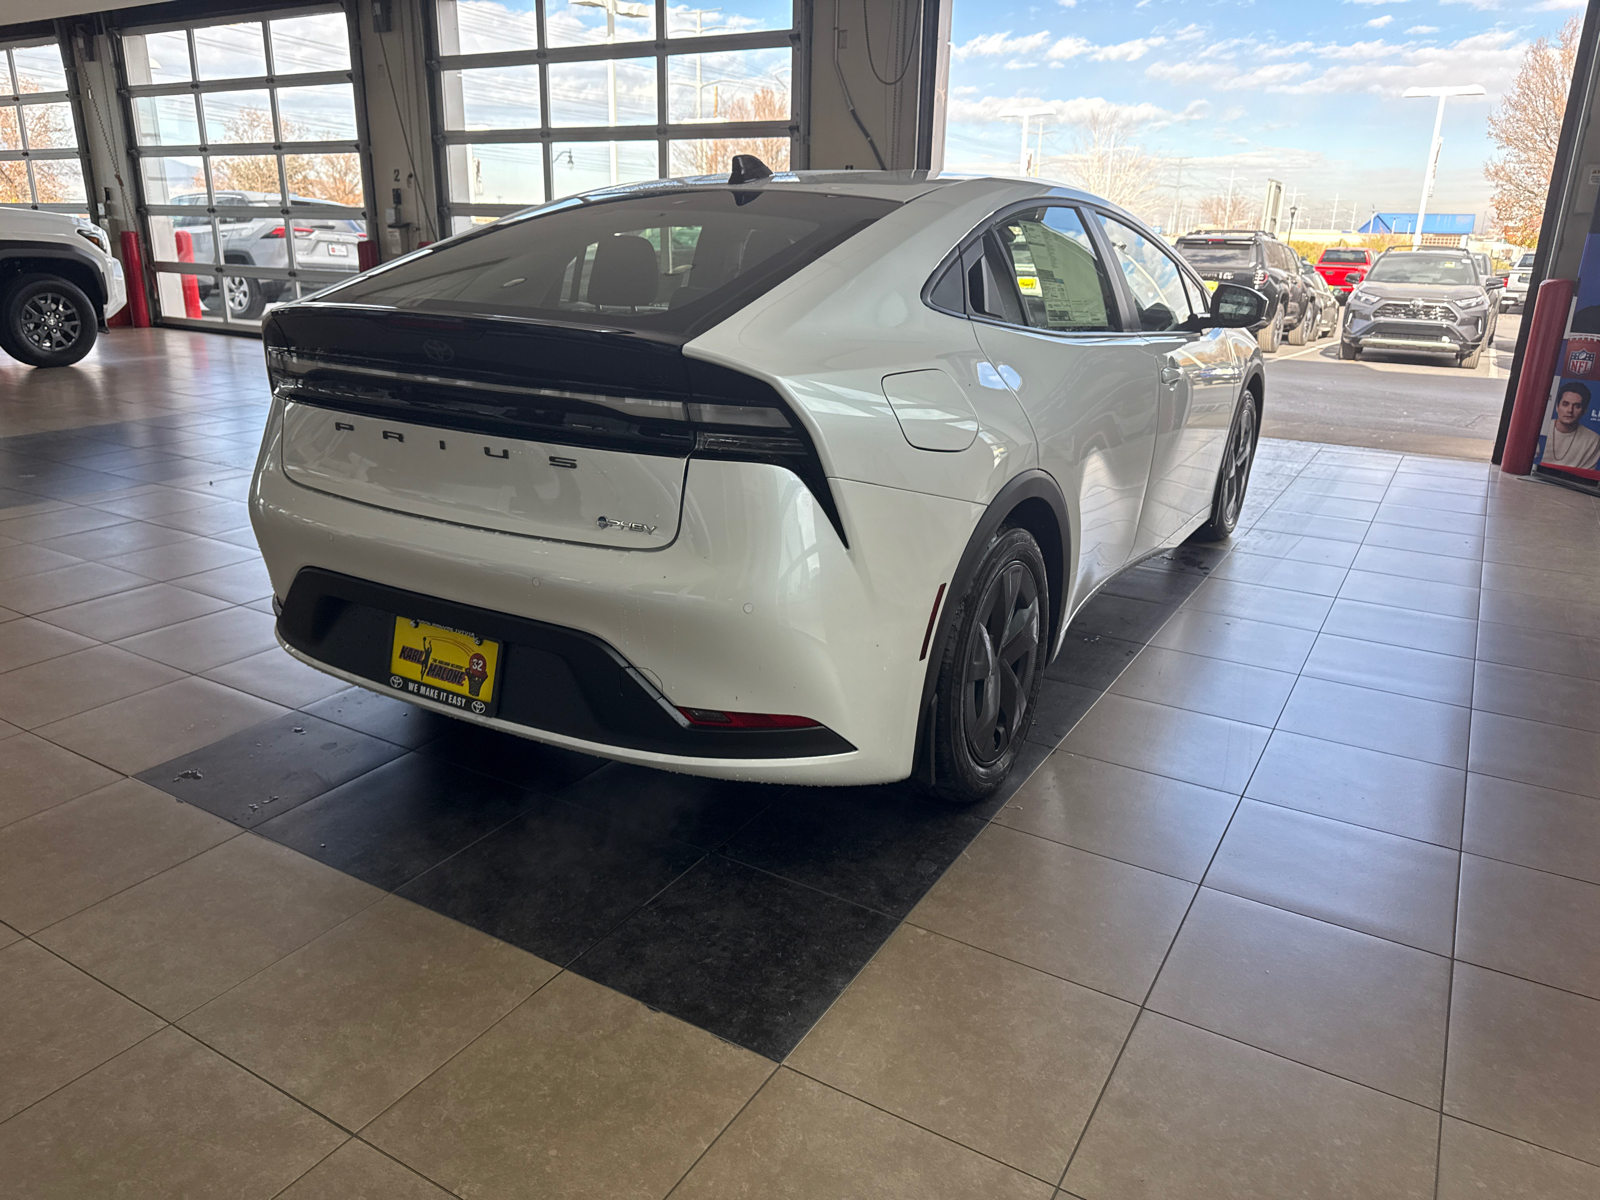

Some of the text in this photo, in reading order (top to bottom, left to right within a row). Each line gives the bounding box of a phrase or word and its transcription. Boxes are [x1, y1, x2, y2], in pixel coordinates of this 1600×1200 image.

[393, 168, 401, 182] 2
[1570, 360, 1592, 375] NFL
[334, 421, 579, 469] PRIUS
[399, 645, 425, 665] KARL
[472, 658, 484, 671] 32
[426, 663, 466, 687] MALONE
[408, 681, 466, 707] WE MAKE IT EASY
